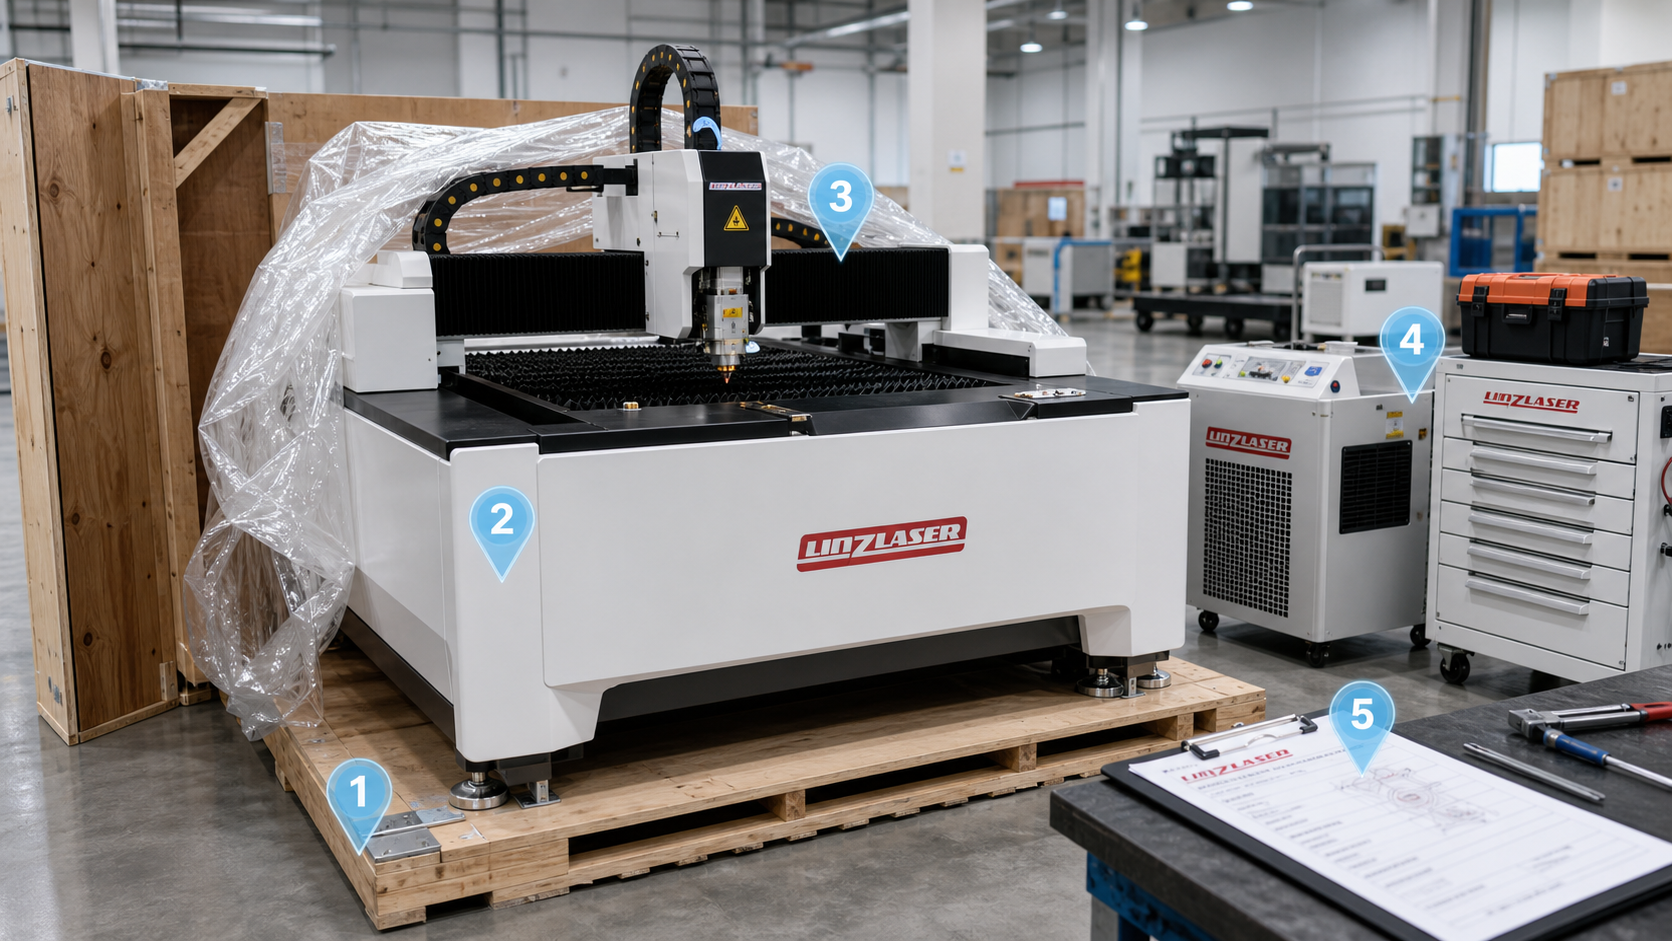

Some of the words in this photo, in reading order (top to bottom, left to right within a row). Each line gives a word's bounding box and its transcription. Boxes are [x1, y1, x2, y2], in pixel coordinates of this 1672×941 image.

[1484, 391, 1580, 411] LINZLASER
[1209, 430, 1289, 453] LINZLASER
[804, 523, 963, 560] LINZLASER
